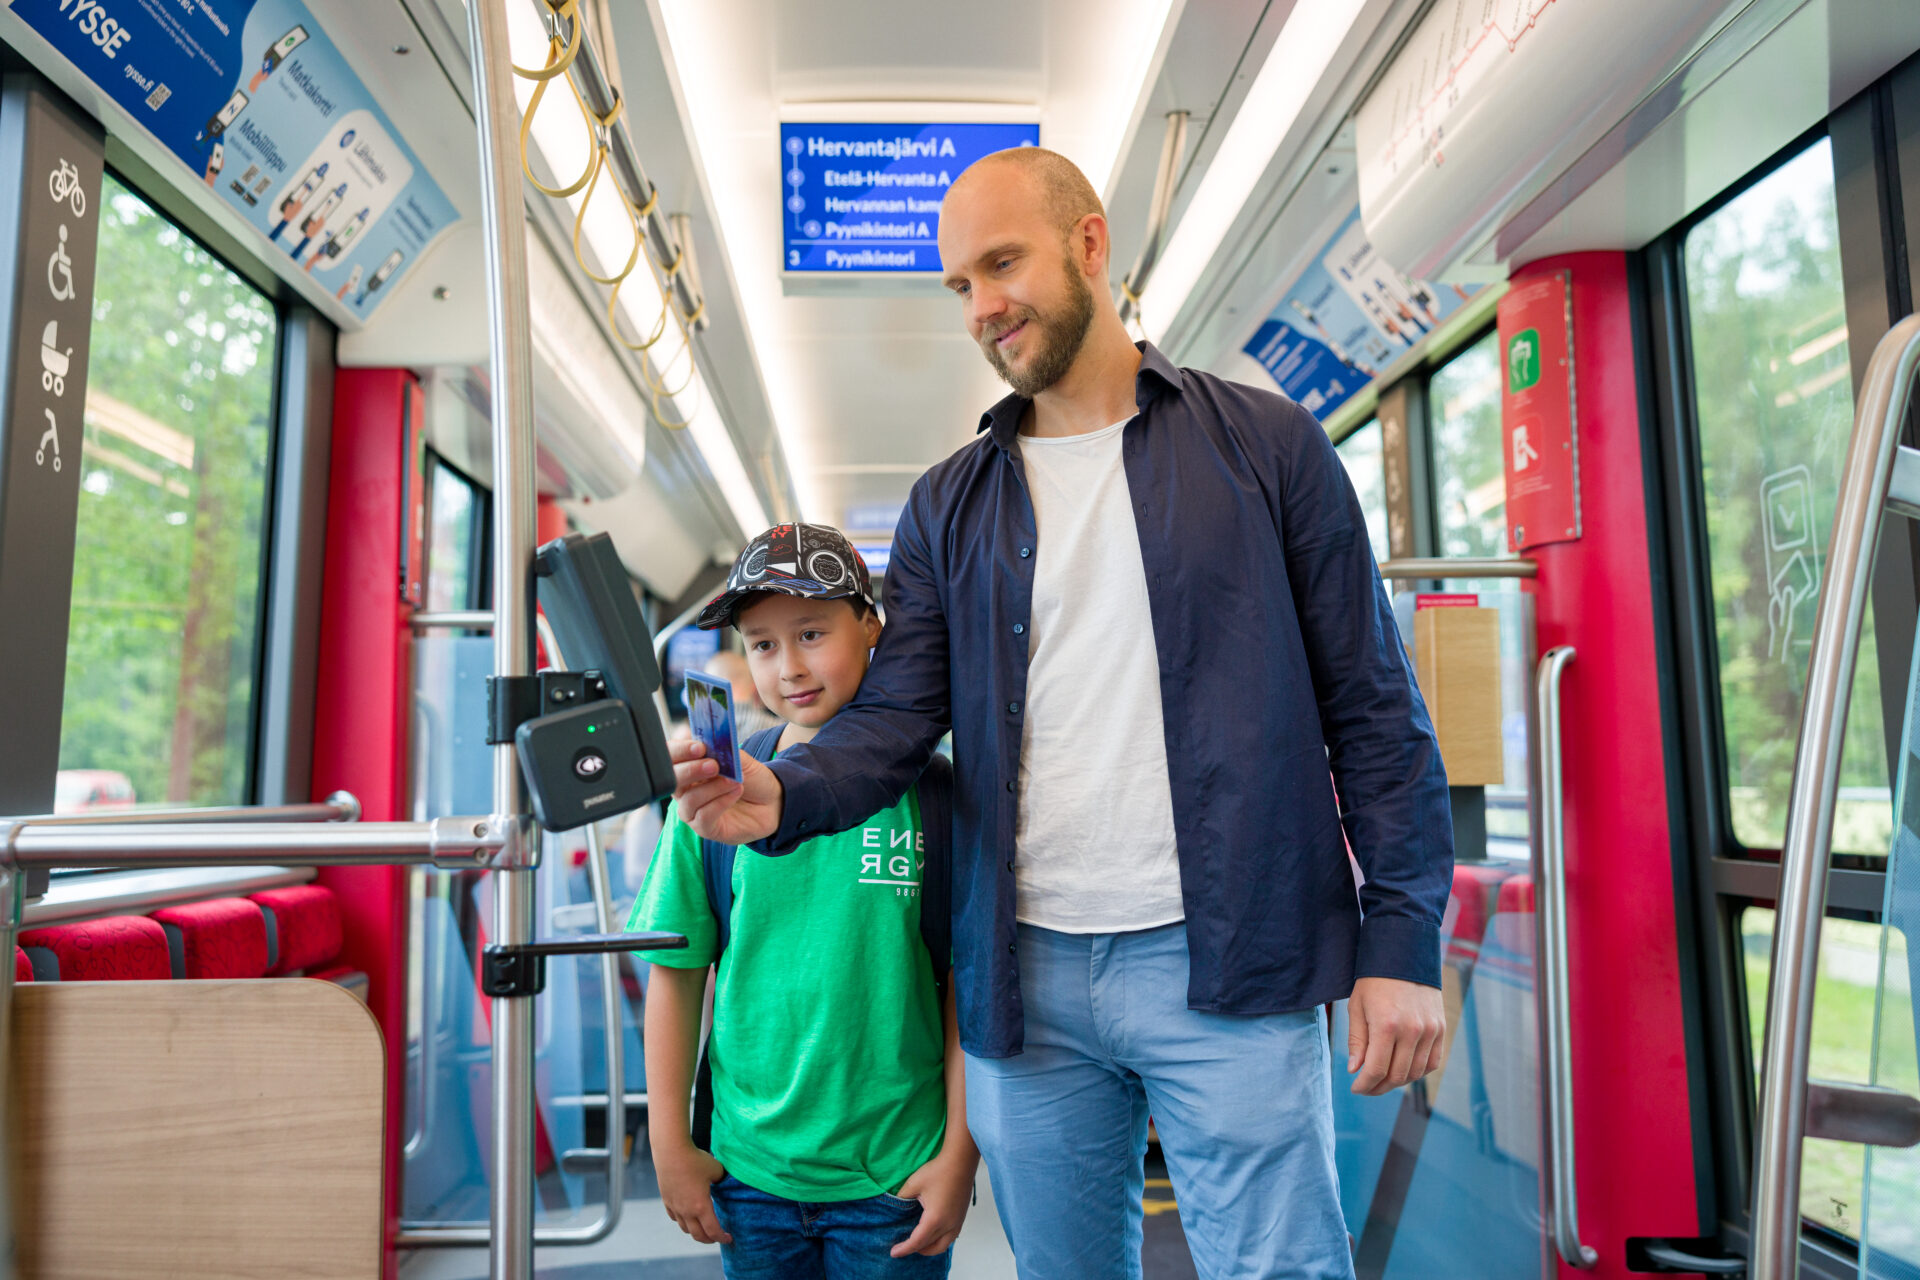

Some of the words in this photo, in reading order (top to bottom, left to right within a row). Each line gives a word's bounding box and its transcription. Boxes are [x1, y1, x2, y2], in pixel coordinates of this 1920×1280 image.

[288, 60, 337, 118] Matkakortti
[808, 137, 937, 161] Hervantajärvi
[939, 137, 956, 158] A
[824, 170, 937, 187] Etelä-Hervanta
[937, 170, 951, 187] A
[824, 196, 906, 213] Hervannan
[825, 221, 915, 240] Pyynikintori
[916, 221, 930, 238] A
[789, 250, 801, 267] 3
[826, 249, 916, 268] Pyynikintori
